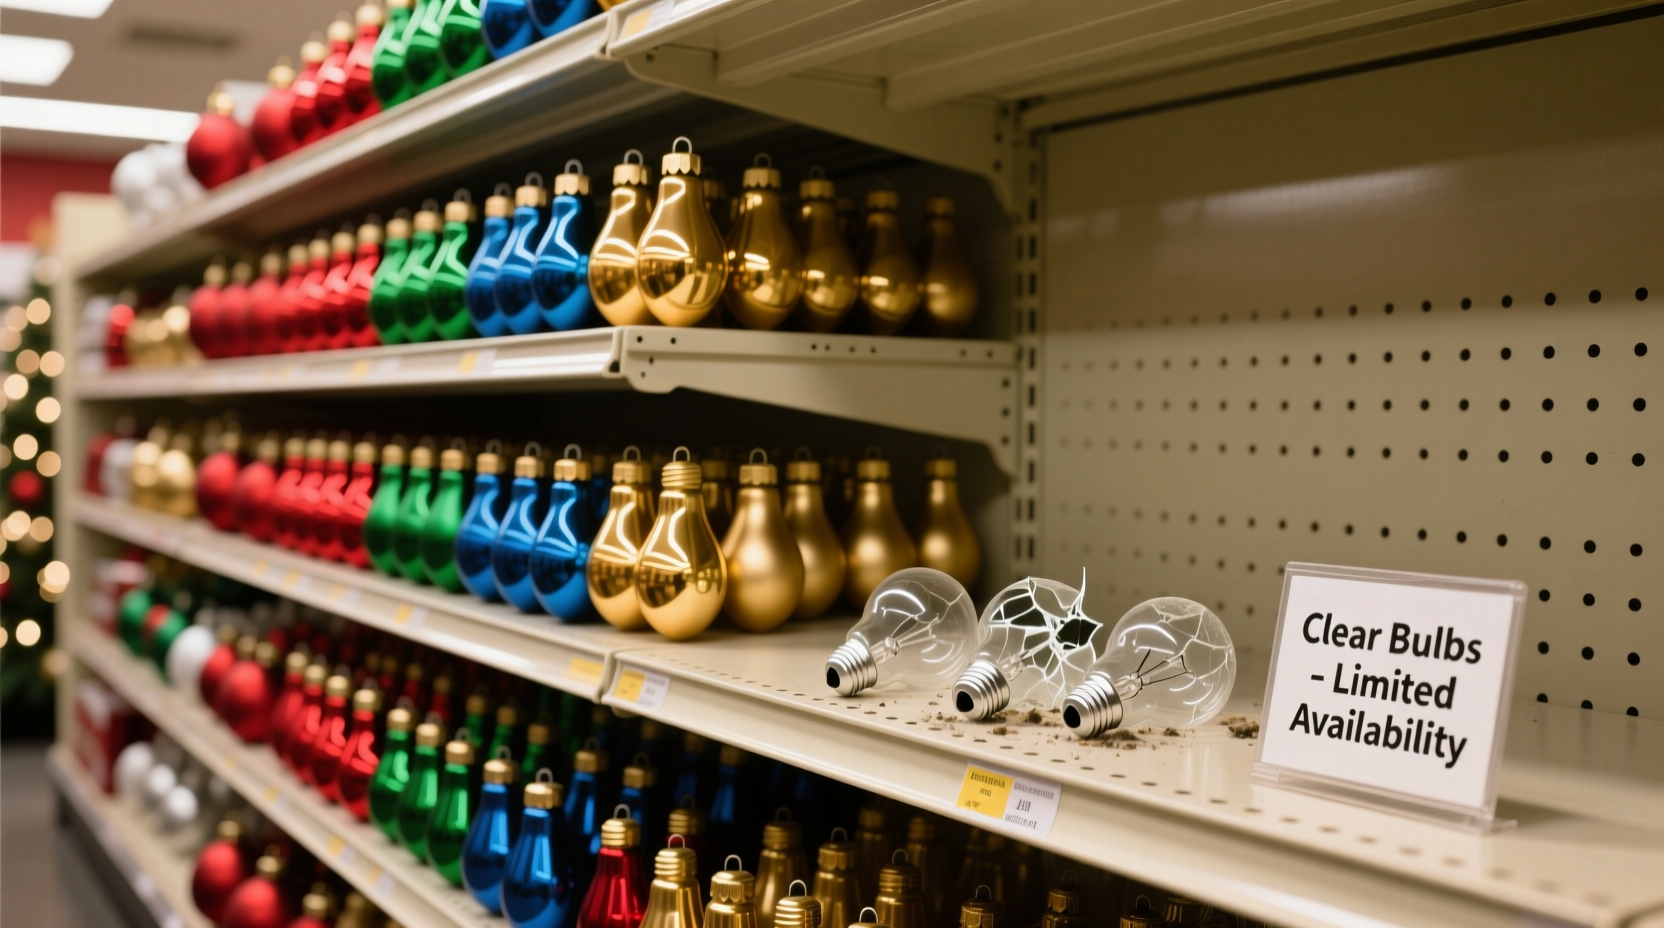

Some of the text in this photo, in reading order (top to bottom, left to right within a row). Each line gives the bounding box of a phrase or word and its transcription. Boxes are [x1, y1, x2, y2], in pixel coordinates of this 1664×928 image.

[1302, 612, 1482, 665] Clear Bulbs
[1332, 662, 1457, 710] Limited
[1288, 702, 1468, 769] Availability
